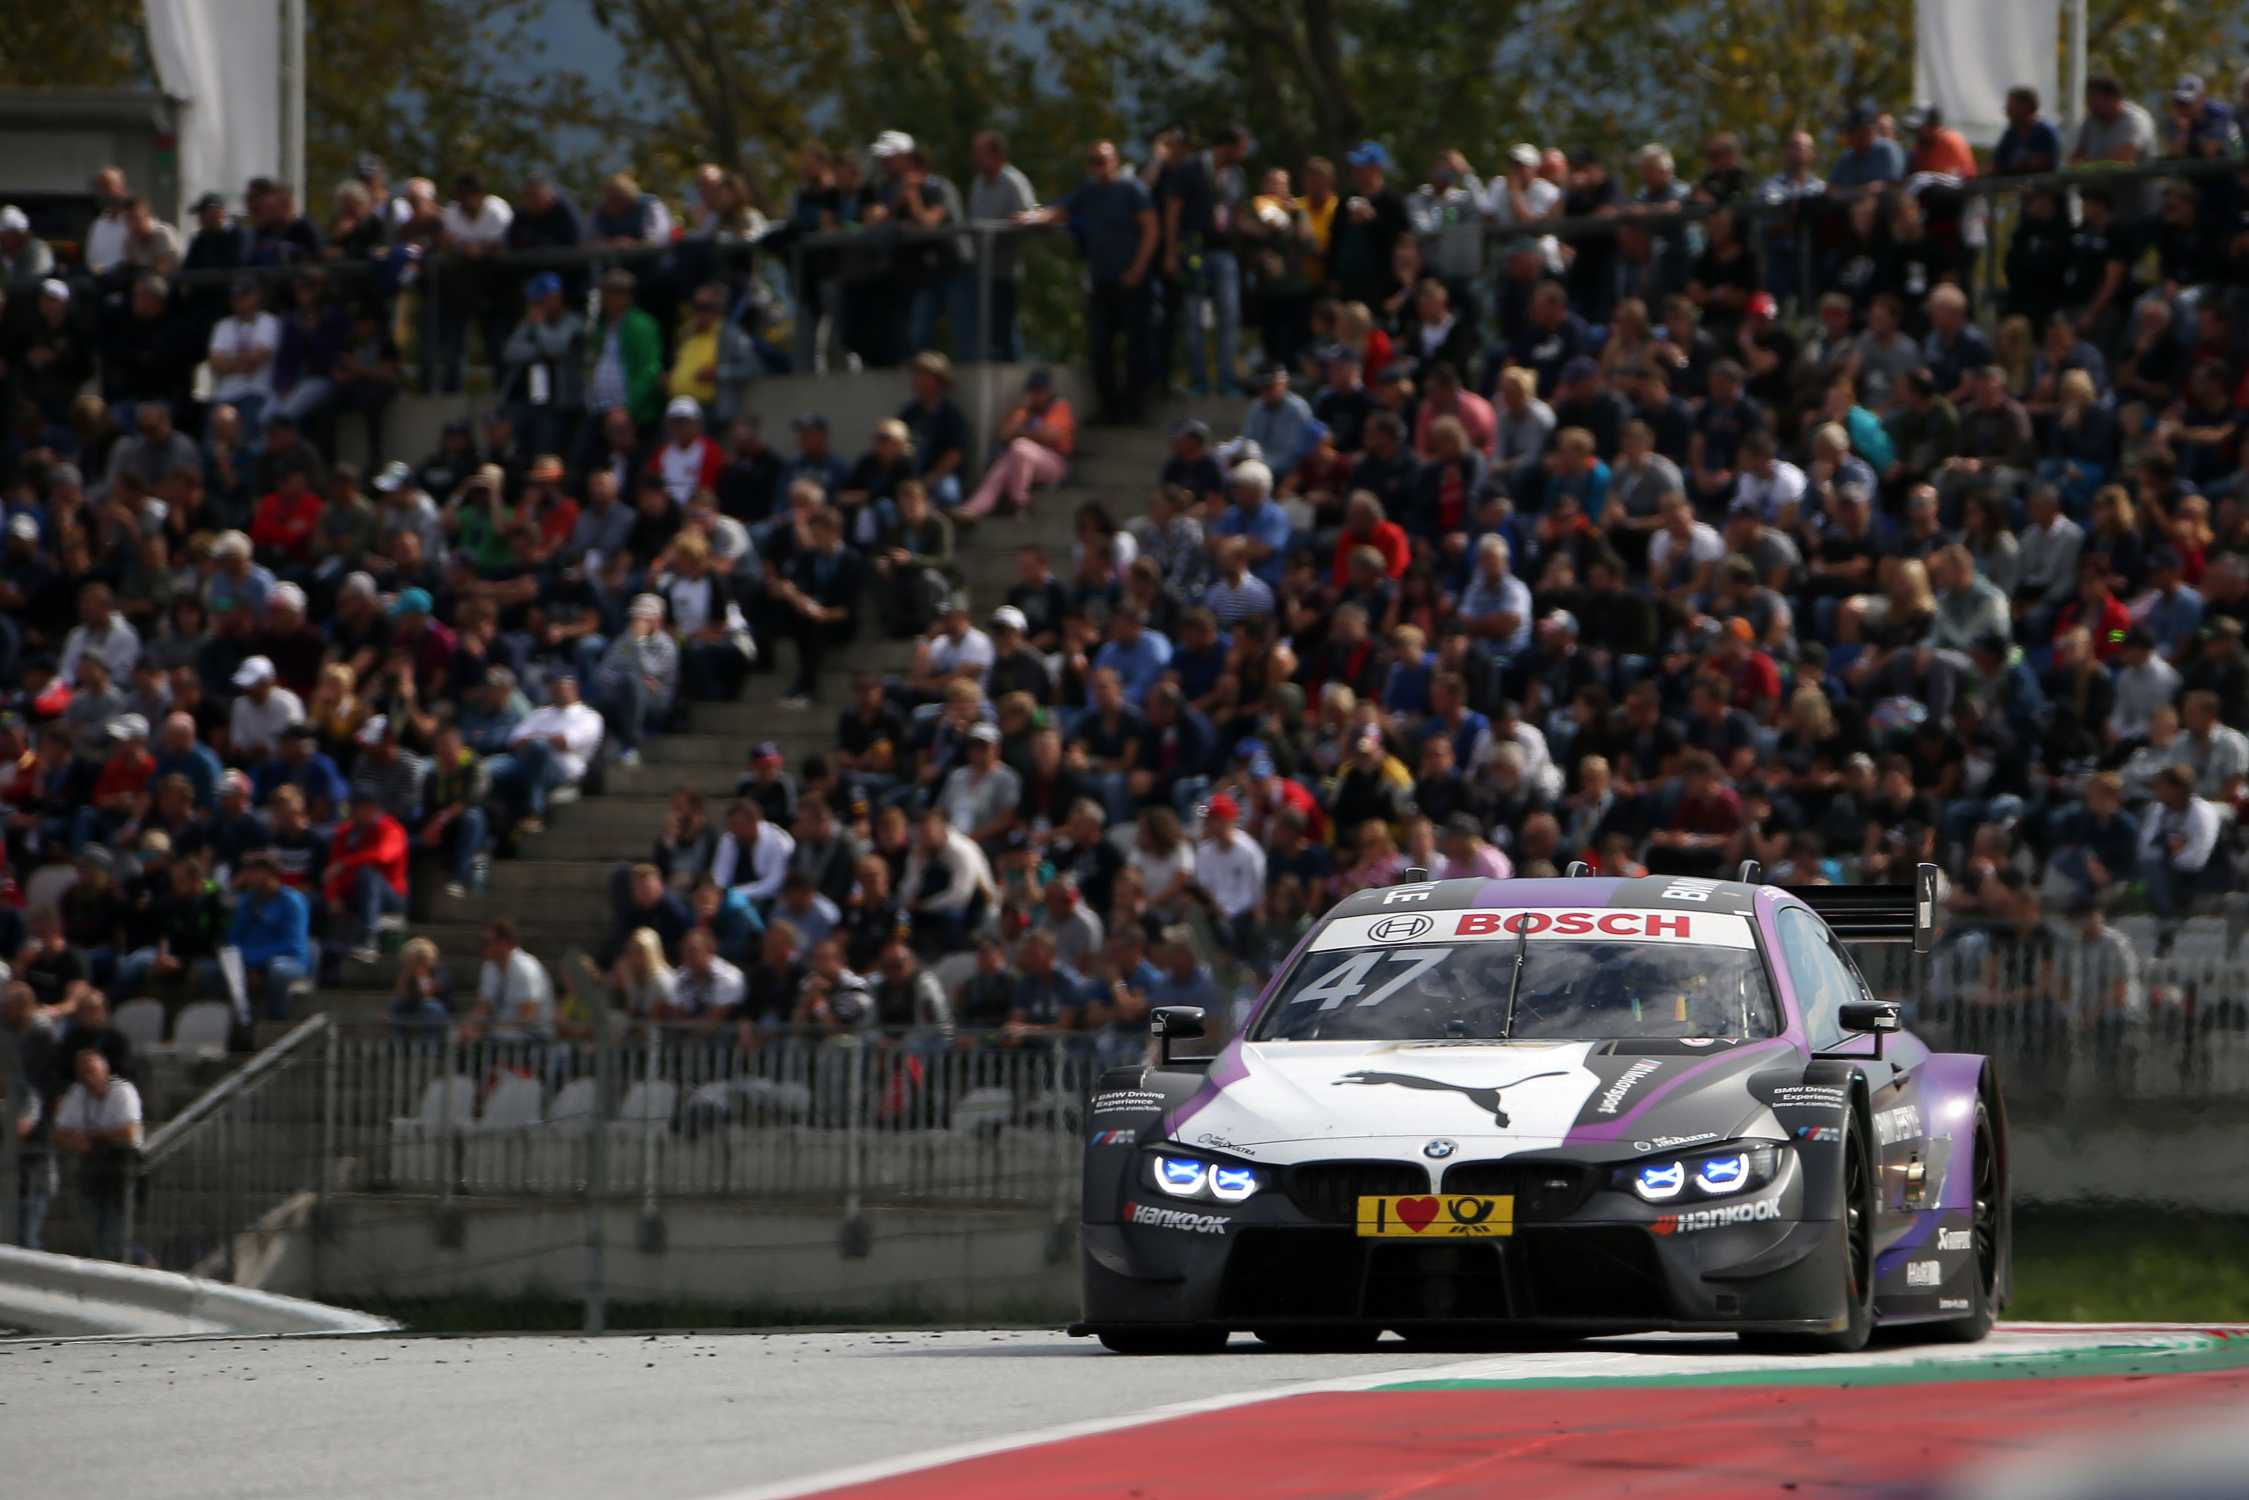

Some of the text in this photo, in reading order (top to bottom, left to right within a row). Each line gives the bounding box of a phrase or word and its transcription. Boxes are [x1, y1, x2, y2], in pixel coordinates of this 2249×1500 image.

[1454, 912, 1691, 939] BOSCH
[1290, 948, 1453, 1011] 47
[1095, 1098, 1154, 1109] Experience
[1127, 1091, 1166, 1100] Driving
[1376, 1198, 1387, 1233] I
